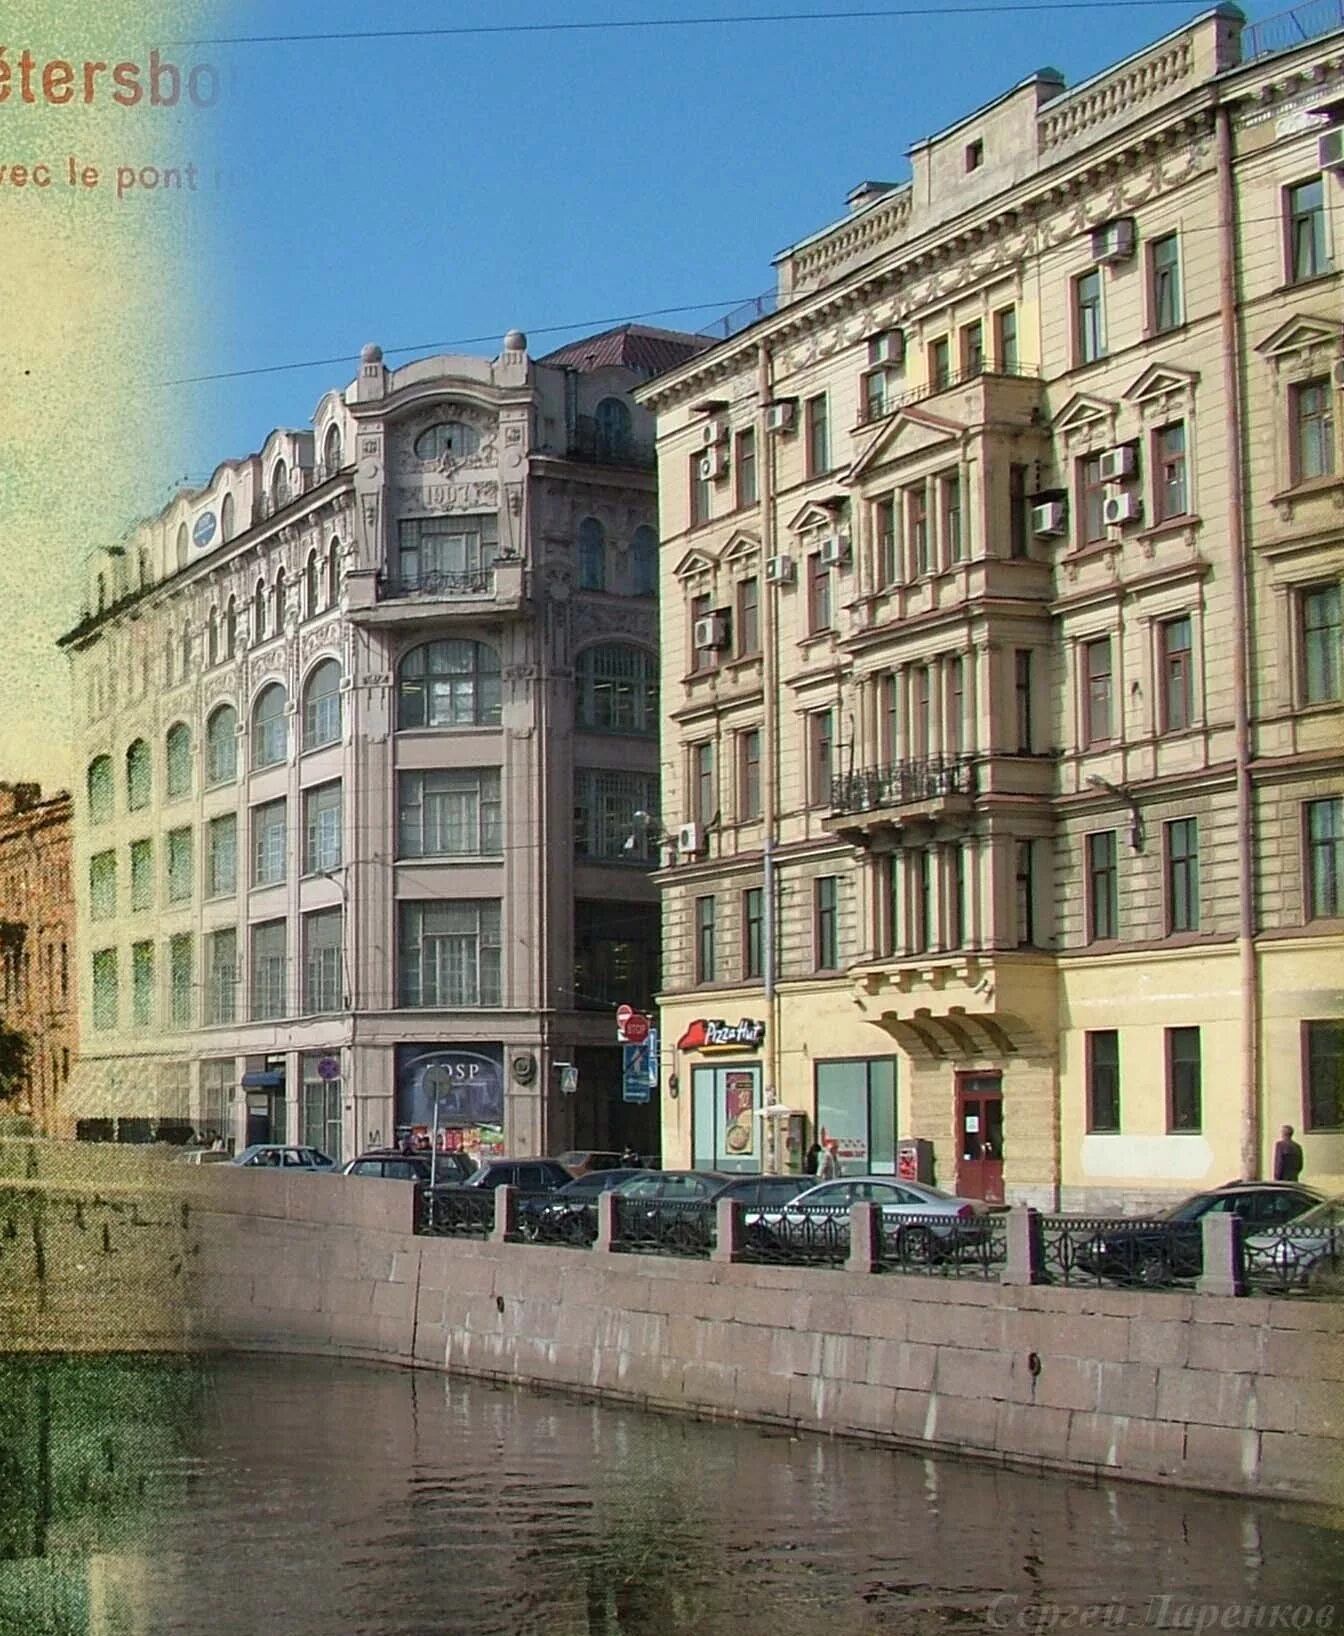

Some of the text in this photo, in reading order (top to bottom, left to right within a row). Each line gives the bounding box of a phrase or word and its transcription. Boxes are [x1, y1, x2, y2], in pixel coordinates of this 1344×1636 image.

[627, 1024, 647, 1034] STOP
[704, 1020, 762, 1045] Pizza Hut
